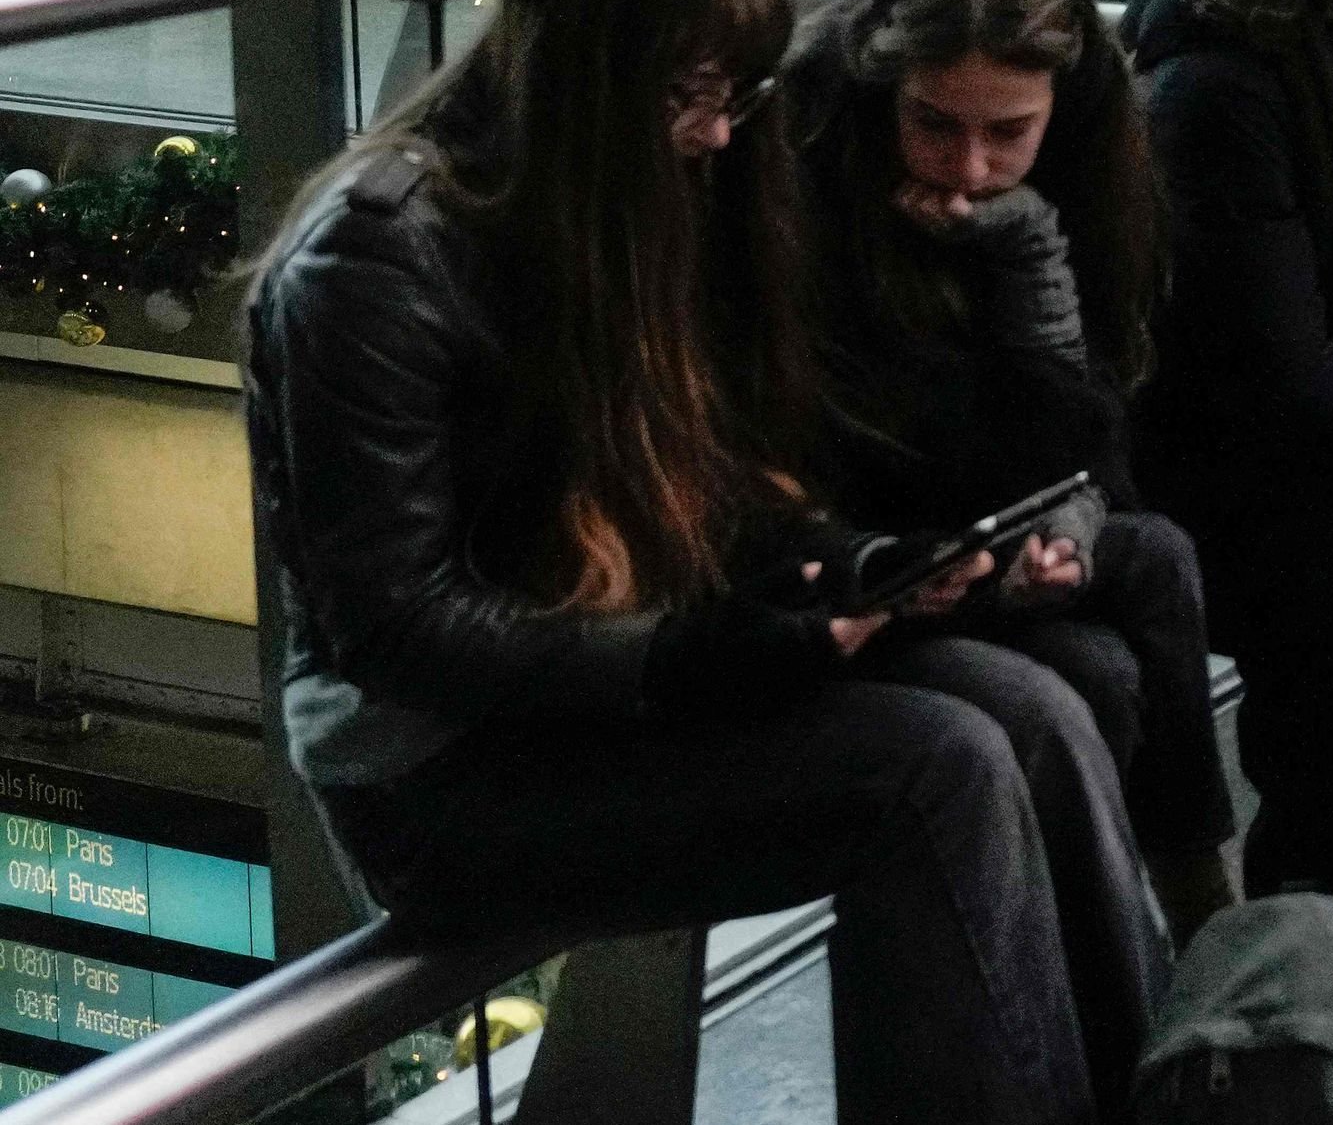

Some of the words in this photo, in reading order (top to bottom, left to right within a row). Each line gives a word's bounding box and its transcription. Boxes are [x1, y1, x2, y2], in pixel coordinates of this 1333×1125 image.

[28, 773, 84, 810] from:
[7, 816, 53, 854] 07:01
[66, 827, 114, 867] Paris
[9, 860, 58, 897] 07:04
[68, 872, 147, 916] Brussels
[14, 945, 59, 982] 08:01
[73, 957, 119, 995] Paris
[75, 1000, 162, 1040] Amsterd
